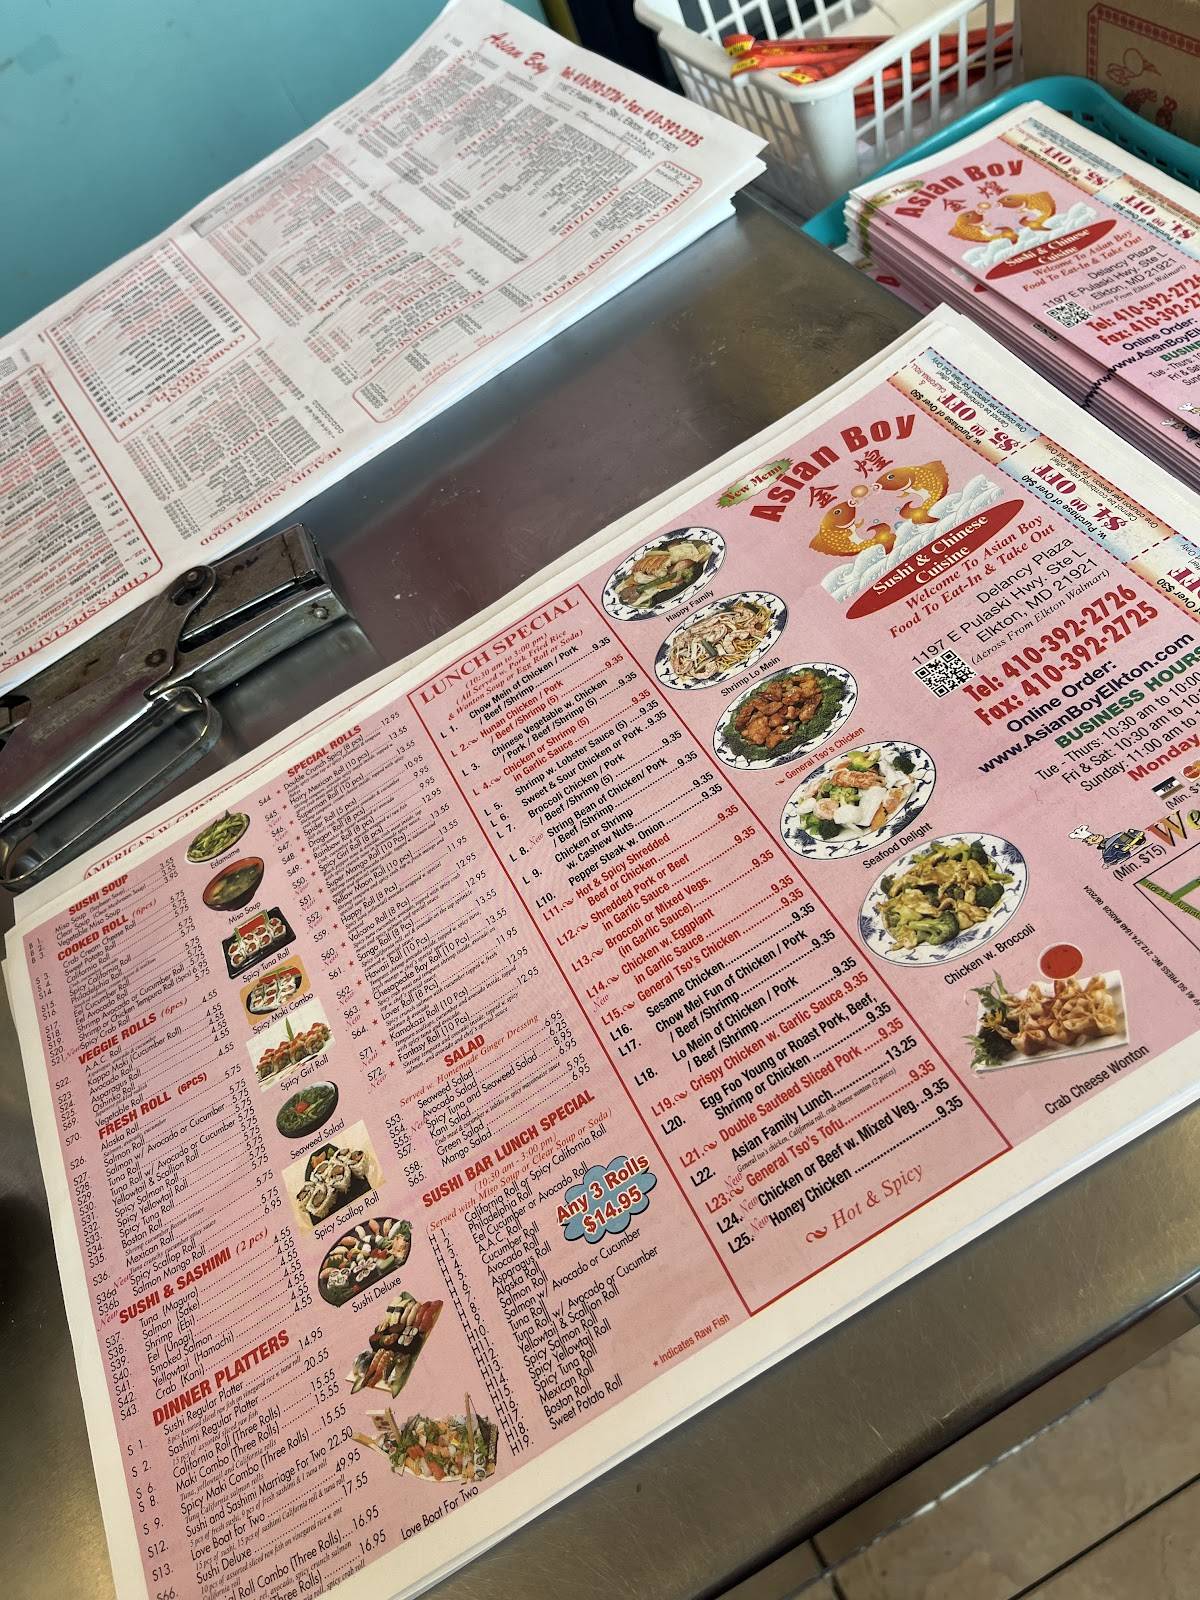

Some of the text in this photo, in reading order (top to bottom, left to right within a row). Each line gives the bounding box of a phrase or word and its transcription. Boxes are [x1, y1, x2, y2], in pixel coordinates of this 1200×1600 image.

[483, 31, 549, 75] Asian Boy
[642, 109, 704, 147] 410-392-2725
[555, 186, 620, 236] APPETIZERS
[640, 175, 703, 223] AMERICAN
[894, 158, 1025, 219] Asian Boy
[587, 233, 631, 270] CHINESE
[1001, 226, 1090, 267] Sushi & Chinese
[1031, 230, 1139, 276] Welcome To Asian Boy
[1037, 246, 1078, 266] Cuisine
[1086, 244, 1157, 279] Delancy Plaza
[541, 270, 586, 308] SPECIAL
[1041, 293, 1067, 309] 1197
[1067, 290, 1080, 298] E
[1076, 276, 1115, 294] Pulaski
[1112, 266, 1140, 280] Hwy.
[1137, 256, 1159, 268] Ste
[1089, 257, 1177, 300] Elkton, MD 21921
[1121, 317, 1198, 351] Online Order:
[936, 392, 976, 421] OFF
[228, 414, 279, 456] SEAFOOD
[749, 412, 917, 523] Asian Boy
[808, 449, 894, 509] 金 煌
[1030, 463, 1077, 494] OFF
[199, 447, 342, 546] HEALTHY AND DIET FOOD
[869, 512, 988, 595] Sushi & Chinese
[889, 523, 1055, 638] Food To Eat-In & Take Out
[904, 515, 1042, 609] Welcome To Asian Boy
[915, 546, 973, 583] Cuisine
[975, 538, 1074, 604] Delancy Plaza
[2, 571, 151, 669] CHEF'S SPECIALTIES
[665, 589, 714, 623] Happy Family
[911, 549, 1087, 665] 1197 E Pulaski Hwy. Ste L
[971, 568, 1110, 666] (Across From Elkton Walmart)
[975, 558, 1098, 643] Elkton, MD 21921
[419, 597, 579, 704] LUNCH SPECIAL
[961, 583, 1137, 702] Tel: 410-392-2726
[973, 600, 1158, 726] Fax: 410-392-2725
[720, 656, 781, 697] Shrimp Lo Mein
[977, 633, 1195, 773] www.AsianBoyElkton.com
[1006, 660, 1117, 732] Online Order:
[491, 679, 608, 757] Chinese Vegetable w. Chicken
[1053, 688, 1145, 749] BUSINESS
[286, 724, 361, 778] SPECIAL ROLLS
[784, 727, 865, 779] General Tso's Chicken
[1079, 737, 1162, 792] Sunday: 11:00
[1126, 733, 1200, 782] Monday
[575, 832, 670, 899] Hot & Spicy Shredded
[862, 822, 933, 869] Seafood Delight
[68, 873, 128, 916] SUSHI SOUP
[57, 914, 129, 961] COOKED ROLL
[943, 922, 1036, 985] Chicken w. Broccoli
[77, 1012, 157, 1065] VEGGIE ROLLS
[443, 1034, 485, 1067] SALAD
[98, 1071, 207, 1140] FRESH ROLL (6PCS)
[718, 1045, 862, 1142] Double Sauteed Sliced Pork
[1044, 1045, 1150, 1114] Crab Cheese Wonton
[422, 1089, 595, 1208] SUSHI BAR LUNCH SPECIAL
[556, 1155, 650, 1227] Any 3 Rolls
[580, 1184, 645, 1236] $14.95
[831, 1164, 922, 1229] Hot & Spicy
[118, 1246, 231, 1324] SUSHI & SASHIMI
[658, 1313, 730, 1364] Indicates Raw Fish
[151, 1329, 289, 1427] DINNER PLATTERS
[400, 1485, 479, 1540] Love Boat For Two
